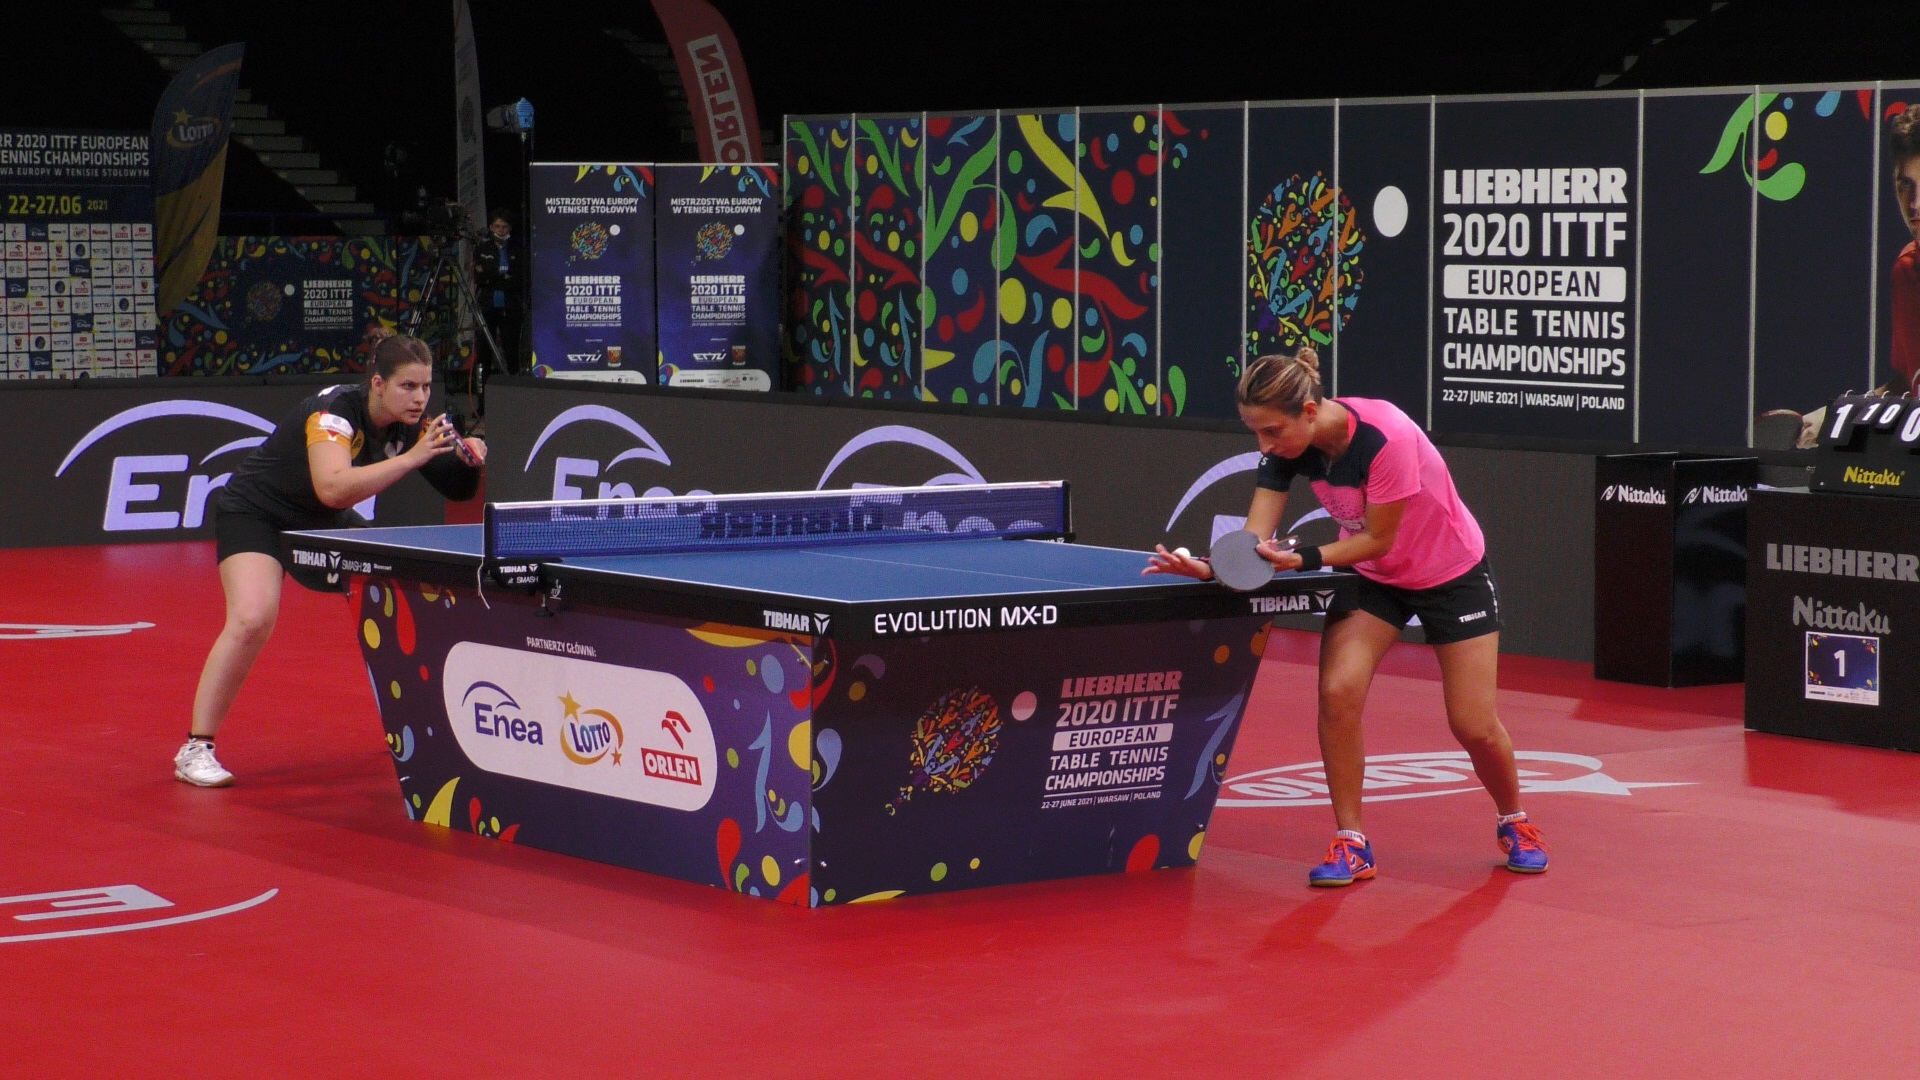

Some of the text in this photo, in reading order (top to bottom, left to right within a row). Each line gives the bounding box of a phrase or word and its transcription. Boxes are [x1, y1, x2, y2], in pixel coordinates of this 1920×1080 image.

[16, 134, 47, 148] 2020
[50, 134, 77, 149] ITTF
[81, 136, 149, 150] EUROPEAN
[179, 123, 214, 141] LOTTO
[45, 151, 149, 166] CHAMPIONSHIPS
[17, 167, 51, 176] EUROPY
[55, 168, 62, 176] W
[66, 168, 99, 176] TENISIE
[1443, 167, 1628, 204] LIEBHERR
[8, 194, 108, 215] 22-27.06 2021
[545, 197, 638, 206] MISTRZOSTWA EUROPY
[547, 206, 557, 214] W
[558, 206, 589, 214] TENISIE
[671, 197, 763, 206] MISTRZOSTWA EUROPY
[673, 206, 682, 214] W
[683, 206, 714, 214] TENISIE
[1443, 212, 1627, 257] 2020 ITTF
[303, 280, 352, 288] LIEBHERR
[565, 275, 621, 284] LIEBHERR
[565, 285, 621, 295] 2020 ITTF
[690, 275, 745, 284] LIEBHERR
[691, 284, 746, 295] 2020 ITTF
[1467, 269, 1601, 298] EUROPEAN
[303, 289, 353, 299] 2020 ITTF
[1443, 307, 1625, 340] TABLE TENNIS
[1443, 342, 1626, 376] CHAMPIONSHIPS
[1442, 389, 1625, 410] 22-27 JUNE 2021 WARSAW POLAND
[1843, 466, 1901, 486] Nittaku
[1618, 484, 1666, 505] Nittaku
[292, 549, 327, 568] TIBHAR
[341, 559, 362, 571] SMASH
[499, 565, 527, 574] TIBHAR
[1766, 542, 1920, 583] LIEBHERR
[516, 575, 539, 584] SMASH
[1249, 594, 1310, 614] TIBHAR
[763, 610, 810, 632] TIBHAR
[874, 604, 1057, 634] EVOLUTION MX-D
[1458, 610, 1487, 623] TIBHAR
[1792, 595, 1891, 635] Nittaku
[526, 636, 565, 653] PARTNERZY
[1833, 649, 1845, 677] 1
[1060, 670, 1183, 699] LIEBHERR
[1055, 693, 1180, 728] 2020 ITTF
[474, 701, 544, 746] Enea
[569, 721, 611, 754] LOTTO
[1068, 726, 1158, 748] EUROPEAN
[644, 751, 699, 782] ORLEN
[1050, 746, 1169, 771] TABLE TENNIS
[1045, 765, 1166, 791] CHAMPIONSHIPS
[1041, 790, 1162, 809] 22-27 JUNE 2021 WARSAW POLAND
